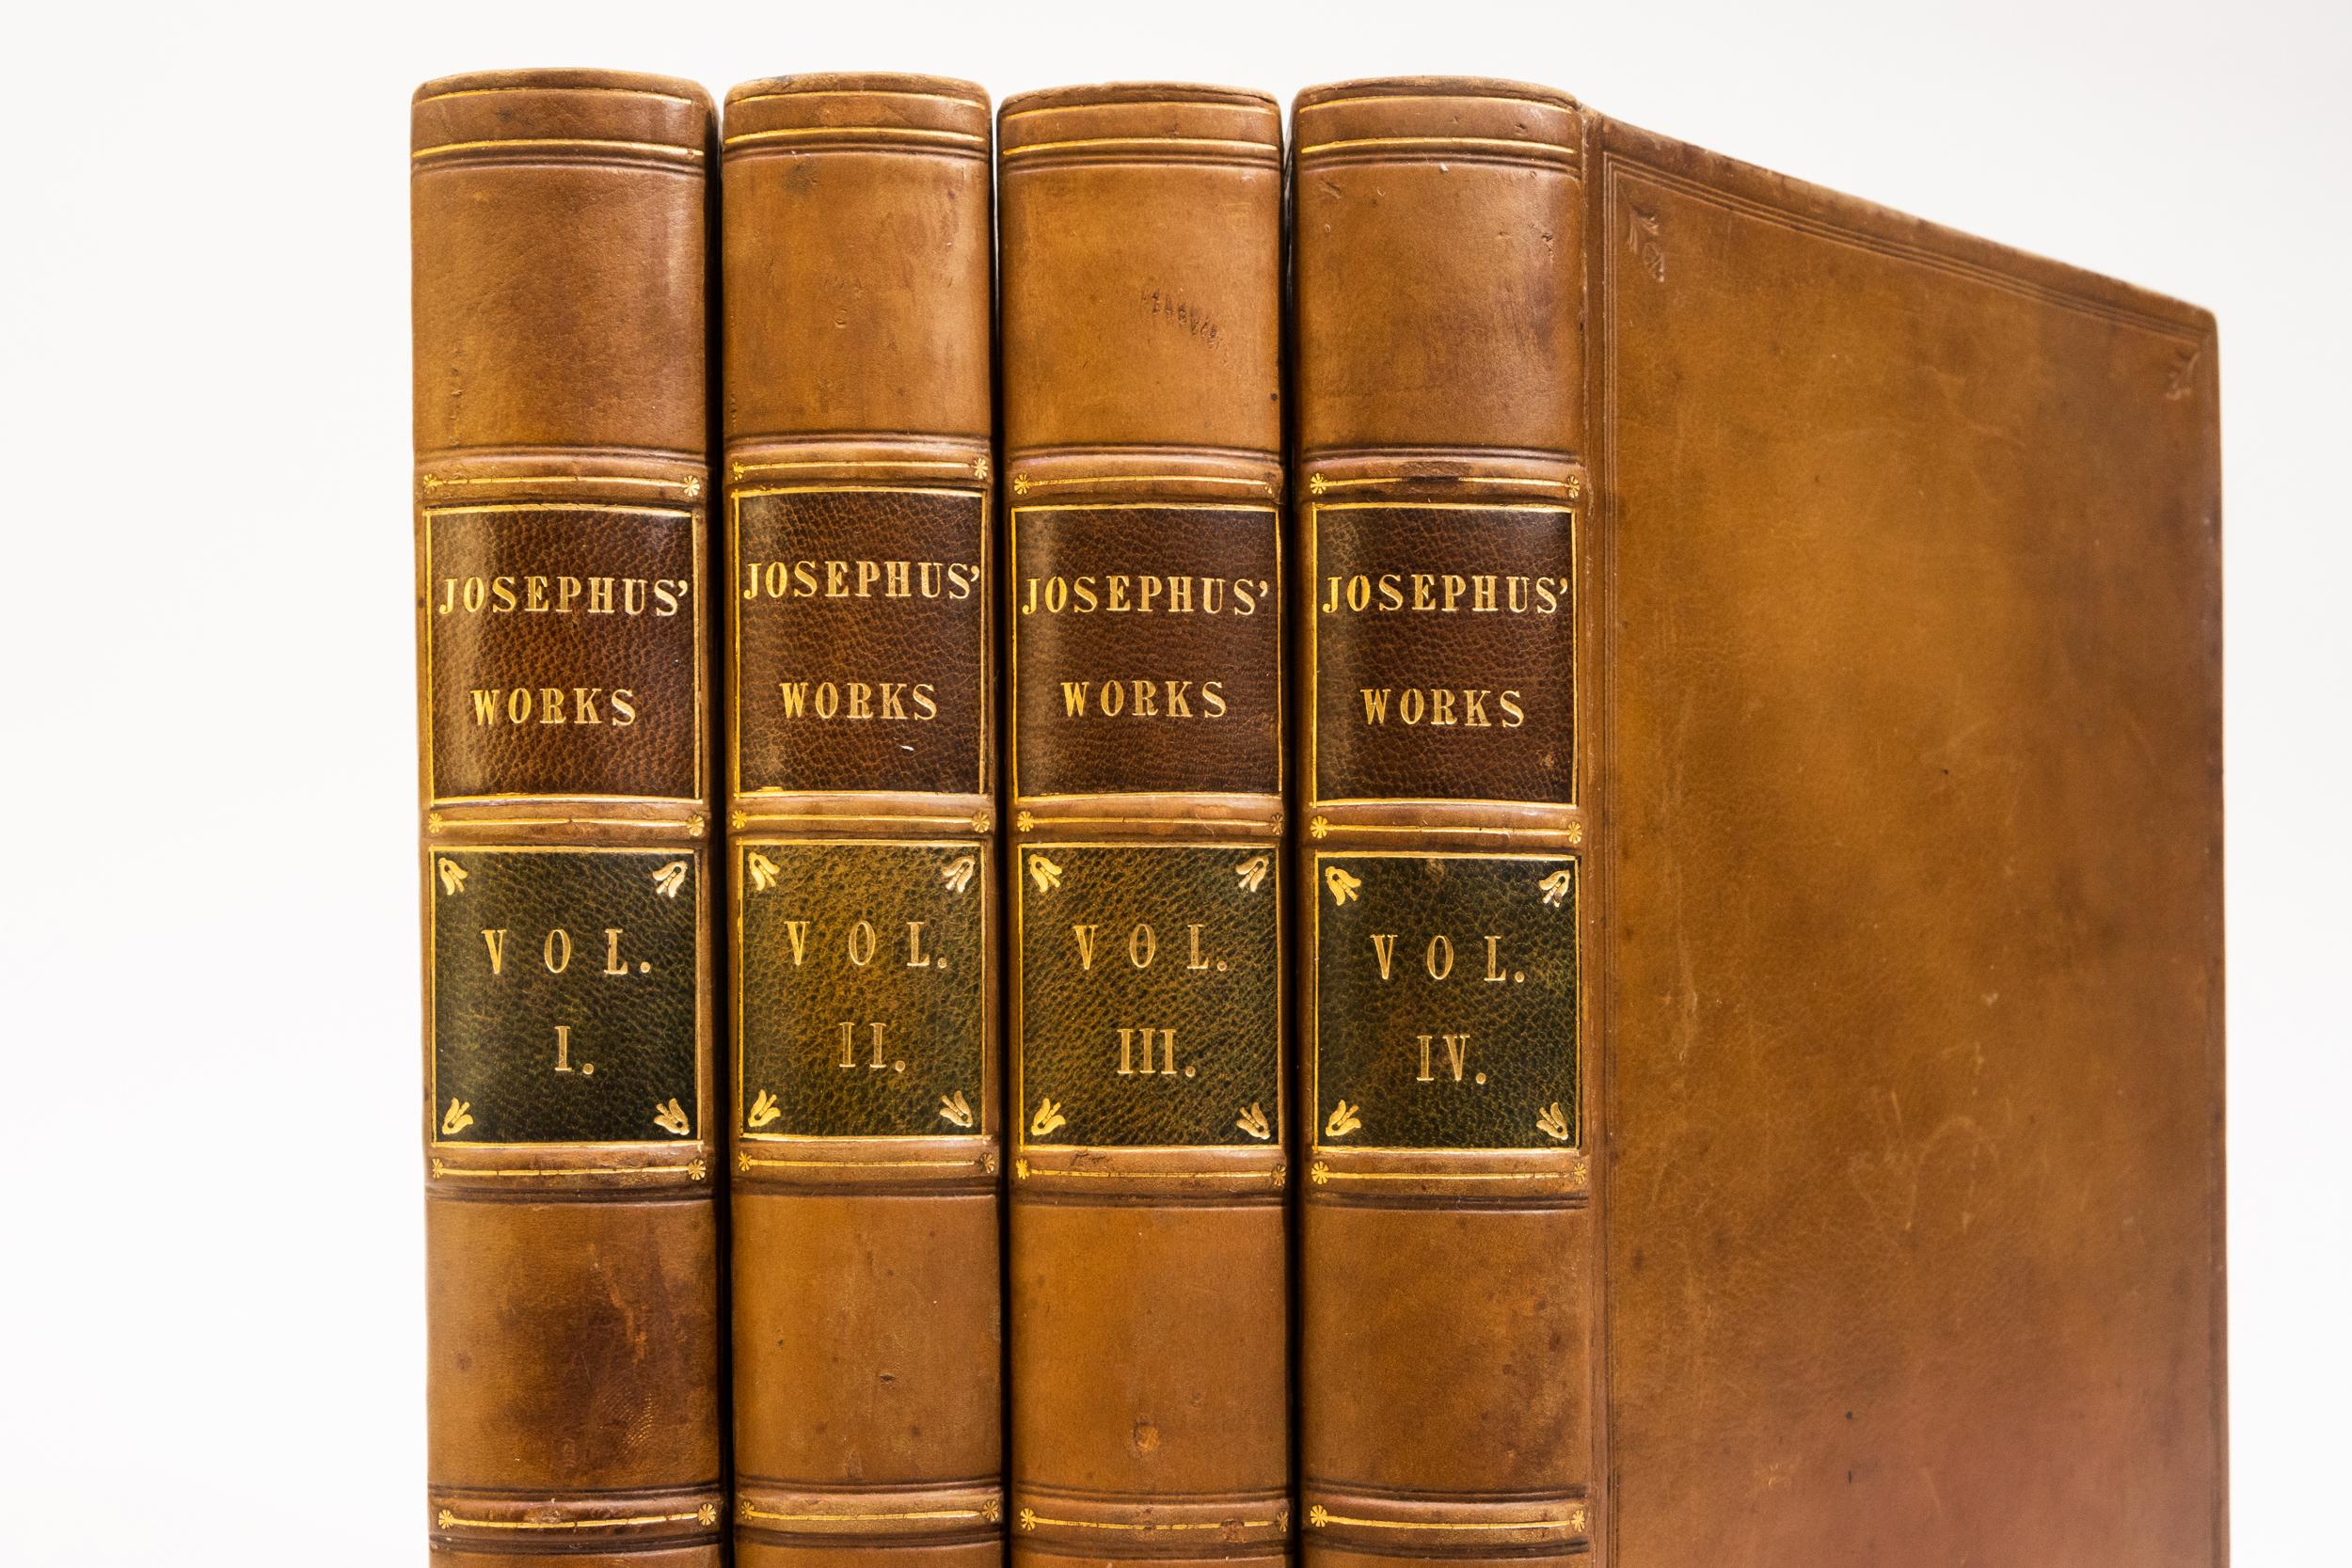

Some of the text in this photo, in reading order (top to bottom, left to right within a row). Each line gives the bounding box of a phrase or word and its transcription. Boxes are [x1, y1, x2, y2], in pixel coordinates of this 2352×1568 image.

[439, 576, 688, 616] JOSEPHUS'
[743, 561, 980, 600] JOSEPHUS'
[1023, 576, 1268, 616] JOSEPHUS'
[1323, 575, 1568, 615] JOSEPHUS'
[470, 688, 636, 727] WORKS
[780, 681, 938, 721] WORKS
[1061, 680, 1227, 719] WORKS
[1361, 689, 1525, 728] WORKS
[482, 928, 651, 974] VOL.
[785, 920, 947, 969] VOL.
[1073, 923, 1228, 972] VOL.
[1371, 934, 1525, 983] VOL.
[554, 1025, 595, 1075] I.
[839, 1022, 906, 1072] II.
[1118, 1028, 1196, 1078] III.
[1416, 1034, 1486, 1085] IV.
